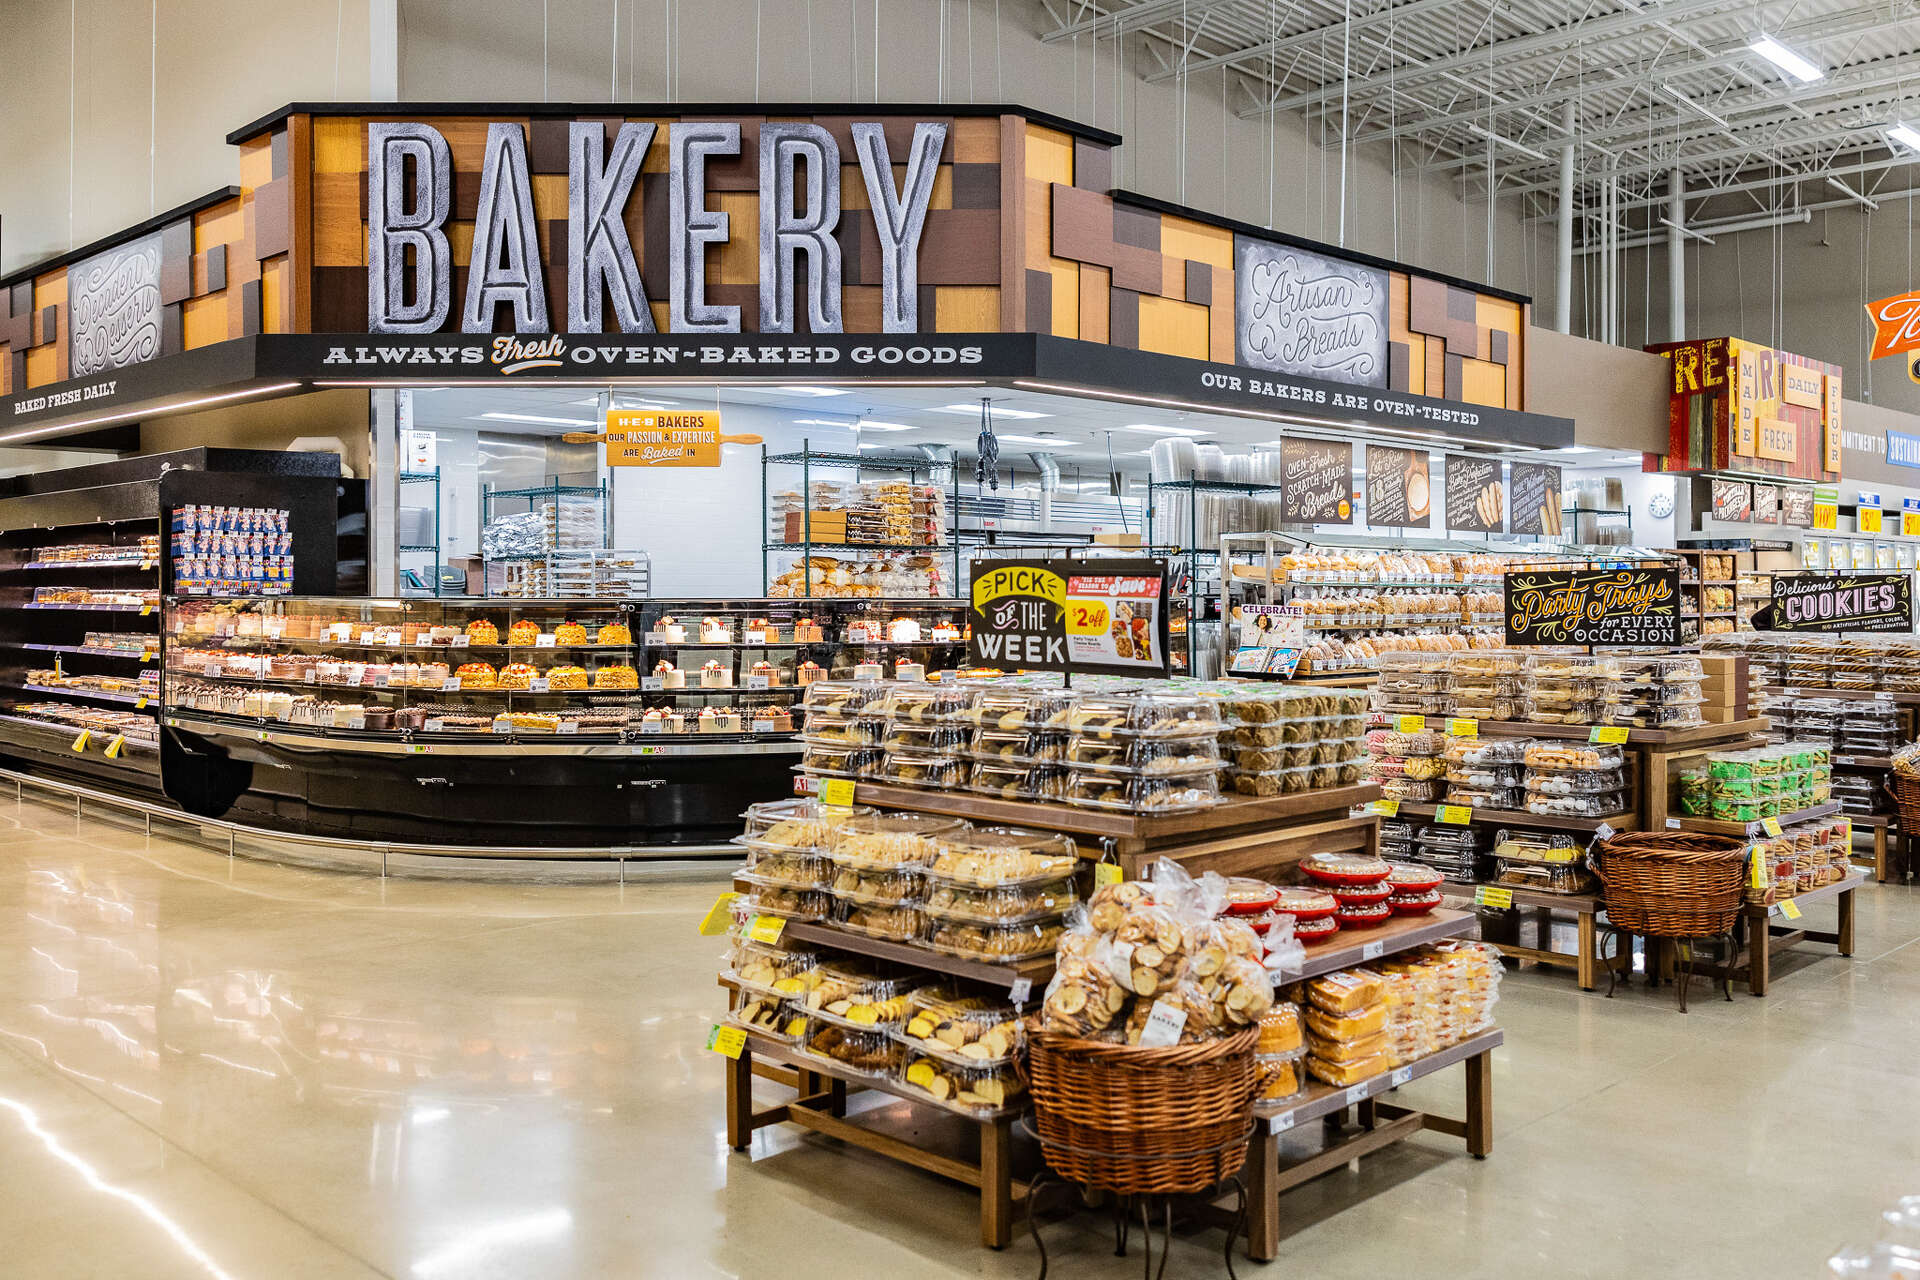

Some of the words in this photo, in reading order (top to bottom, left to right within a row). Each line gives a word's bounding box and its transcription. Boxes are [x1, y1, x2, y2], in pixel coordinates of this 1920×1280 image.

[368, 121, 949, 335] BAKERY
[76, 248, 157, 343] Decadent
[1252, 268, 1353, 328] Artisan
[79, 290, 157, 374] Desserts
[1283, 315, 1364, 362] Breads
[323, 347, 484, 364] ALWAYS
[491, 333, 567, 364] Fresh
[850, 346, 983, 364] GOODS
[14, 397, 46, 415] BAKED
[48, 391, 82, 408] FRESH
[83, 381, 117, 400] DAILY
[1201, 372, 1242, 391] OUR
[1249, 379, 1326, 405] BAKERS
[1332, 393, 1368, 410] ARE
[1374, 399, 1480, 426] OVEN-TESTED
[1787, 377, 1820, 395] DAILY
[1742, 363, 1753, 443] MADE
[657, 416, 704, 428] BAKERS
[1831, 386, 1840, 462] FLOUR
[608, 433, 625, 441] OUR
[626, 431, 663, 443] PASSION
[671, 431, 715, 443] EXPERTISE
[1763, 428, 1793, 452] FRESH
[623, 448, 639, 457] ARE
[640, 445, 684, 460] Baked
[687, 448, 695, 457] IN
[1288, 449, 1336, 474] OVEN-Fresh
[1286, 464, 1346, 505] SCRATCH-MADE
[1301, 480, 1346, 520] Breads
[994, 572, 1046, 594] PICK
[1108, 576, 1146, 596] Save
[1773, 580, 1835, 598] Delicious
[1242, 605, 1302, 615] CELEBRATE!
[1511, 577, 1590, 633] Party
[1587, 572, 1673, 623] Trays
[1786, 583, 1896, 623] COOKIES
[995, 602, 1016, 625] OF
[1021, 602, 1047, 631] THE
[1072, 607, 1088, 627] $2
[1089, 609, 1106, 628] off
[1600, 617, 1620, 630] for
[1620, 615, 1675, 628] EVERY
[1832, 621, 1861, 629] ARTIFICIAL
[1871, 622, 1909, 631] PRESERVATIVES
[976, 634, 1065, 664] WEEK
[1574, 629, 1675, 642] OCCASION
[794, 776, 808, 792] A1
